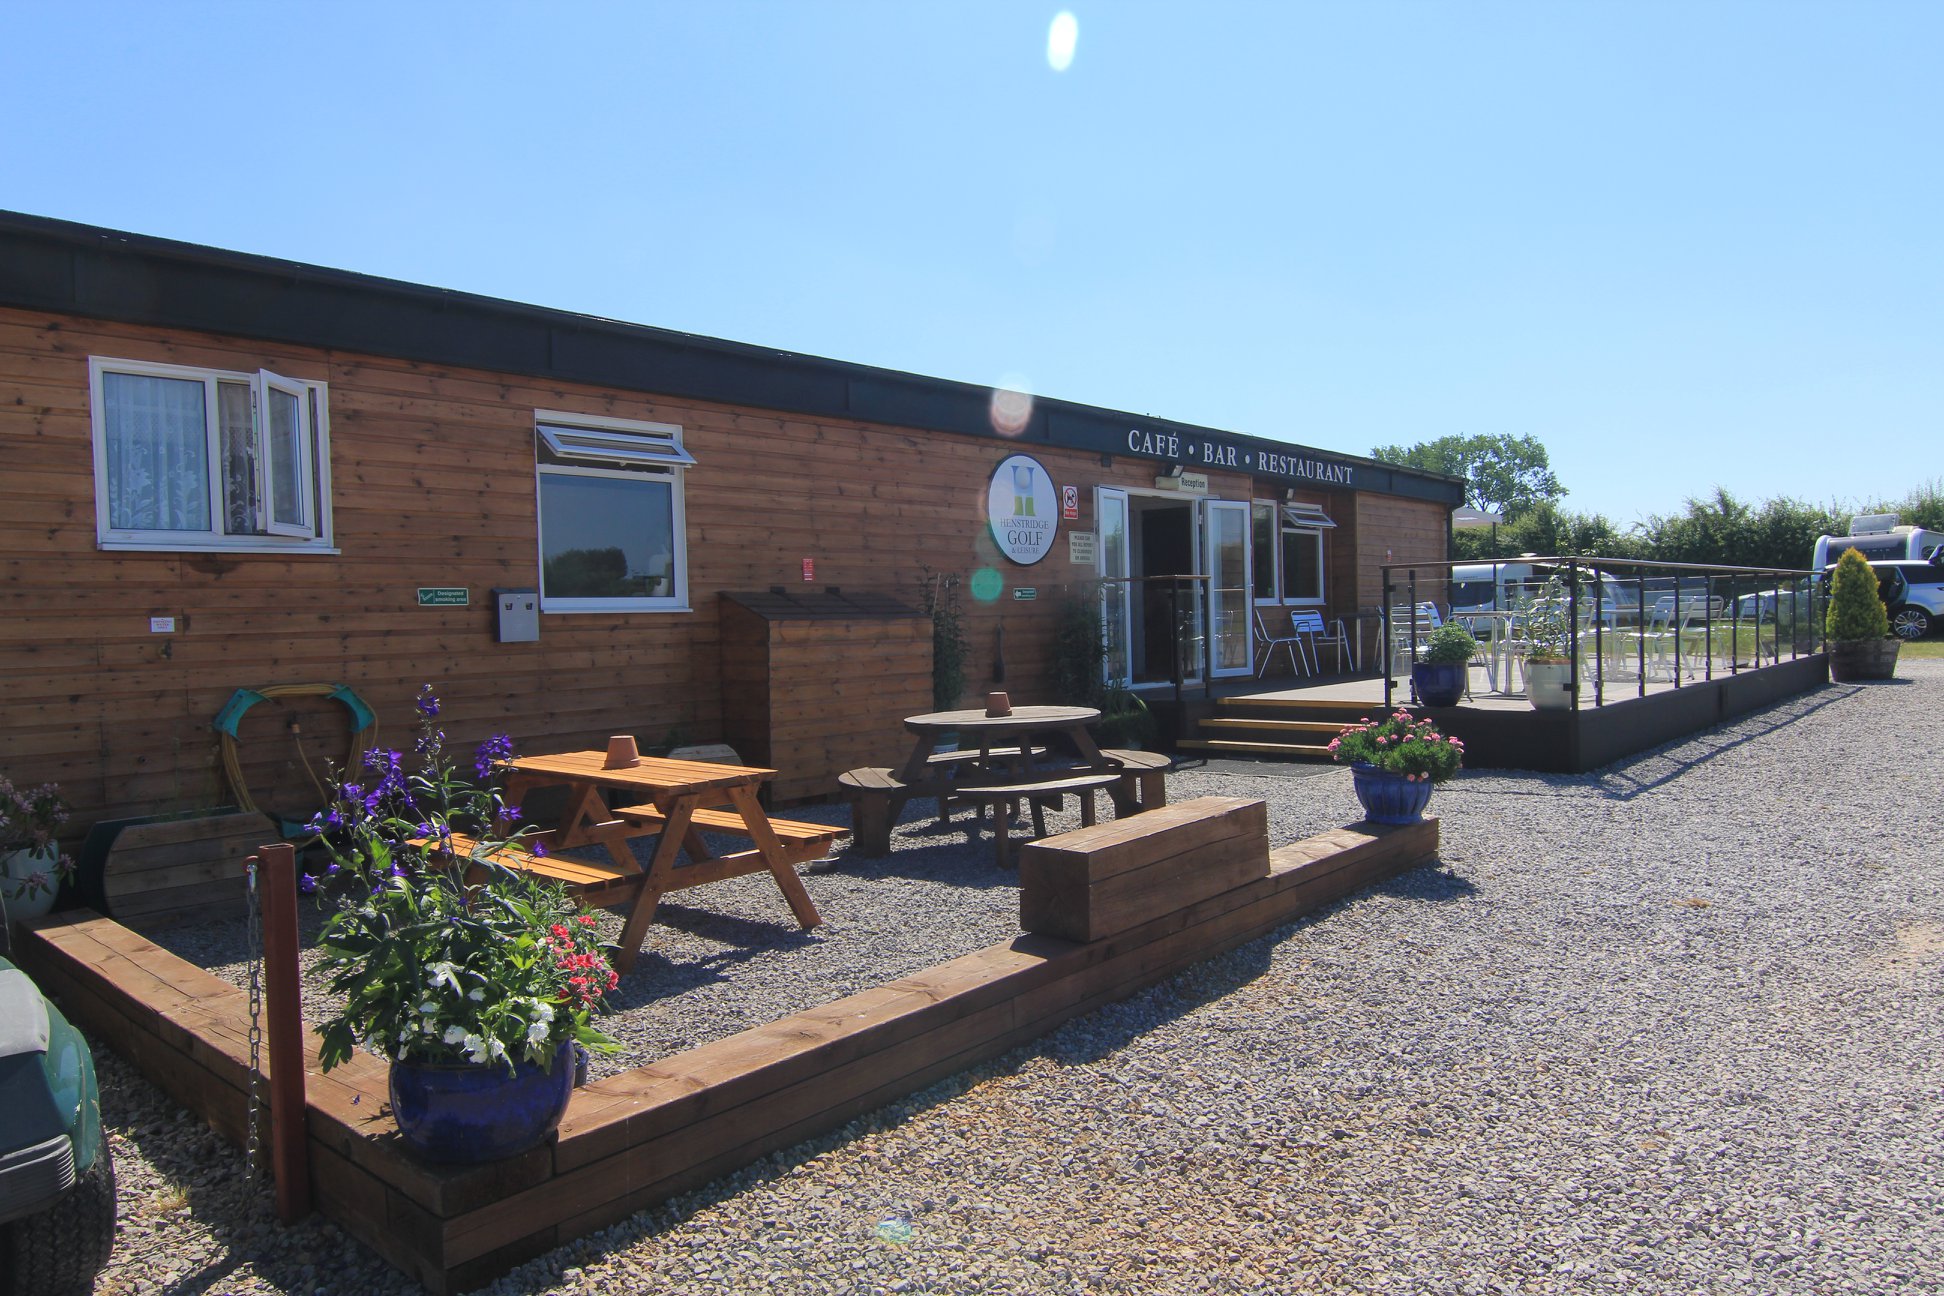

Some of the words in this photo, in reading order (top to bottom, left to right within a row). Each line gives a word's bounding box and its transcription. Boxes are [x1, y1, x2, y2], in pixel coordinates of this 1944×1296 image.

[1128, 430, 1179, 458] CAFÉ
[1203, 442, 1237, 466] BAR
[1258, 451, 1353, 484] RESTAURANT
[1181, 477, 1206, 489] Reception
[1000, 517, 1049, 530] HENSTRIDGE
[1007, 530, 1043, 546] GOLF
